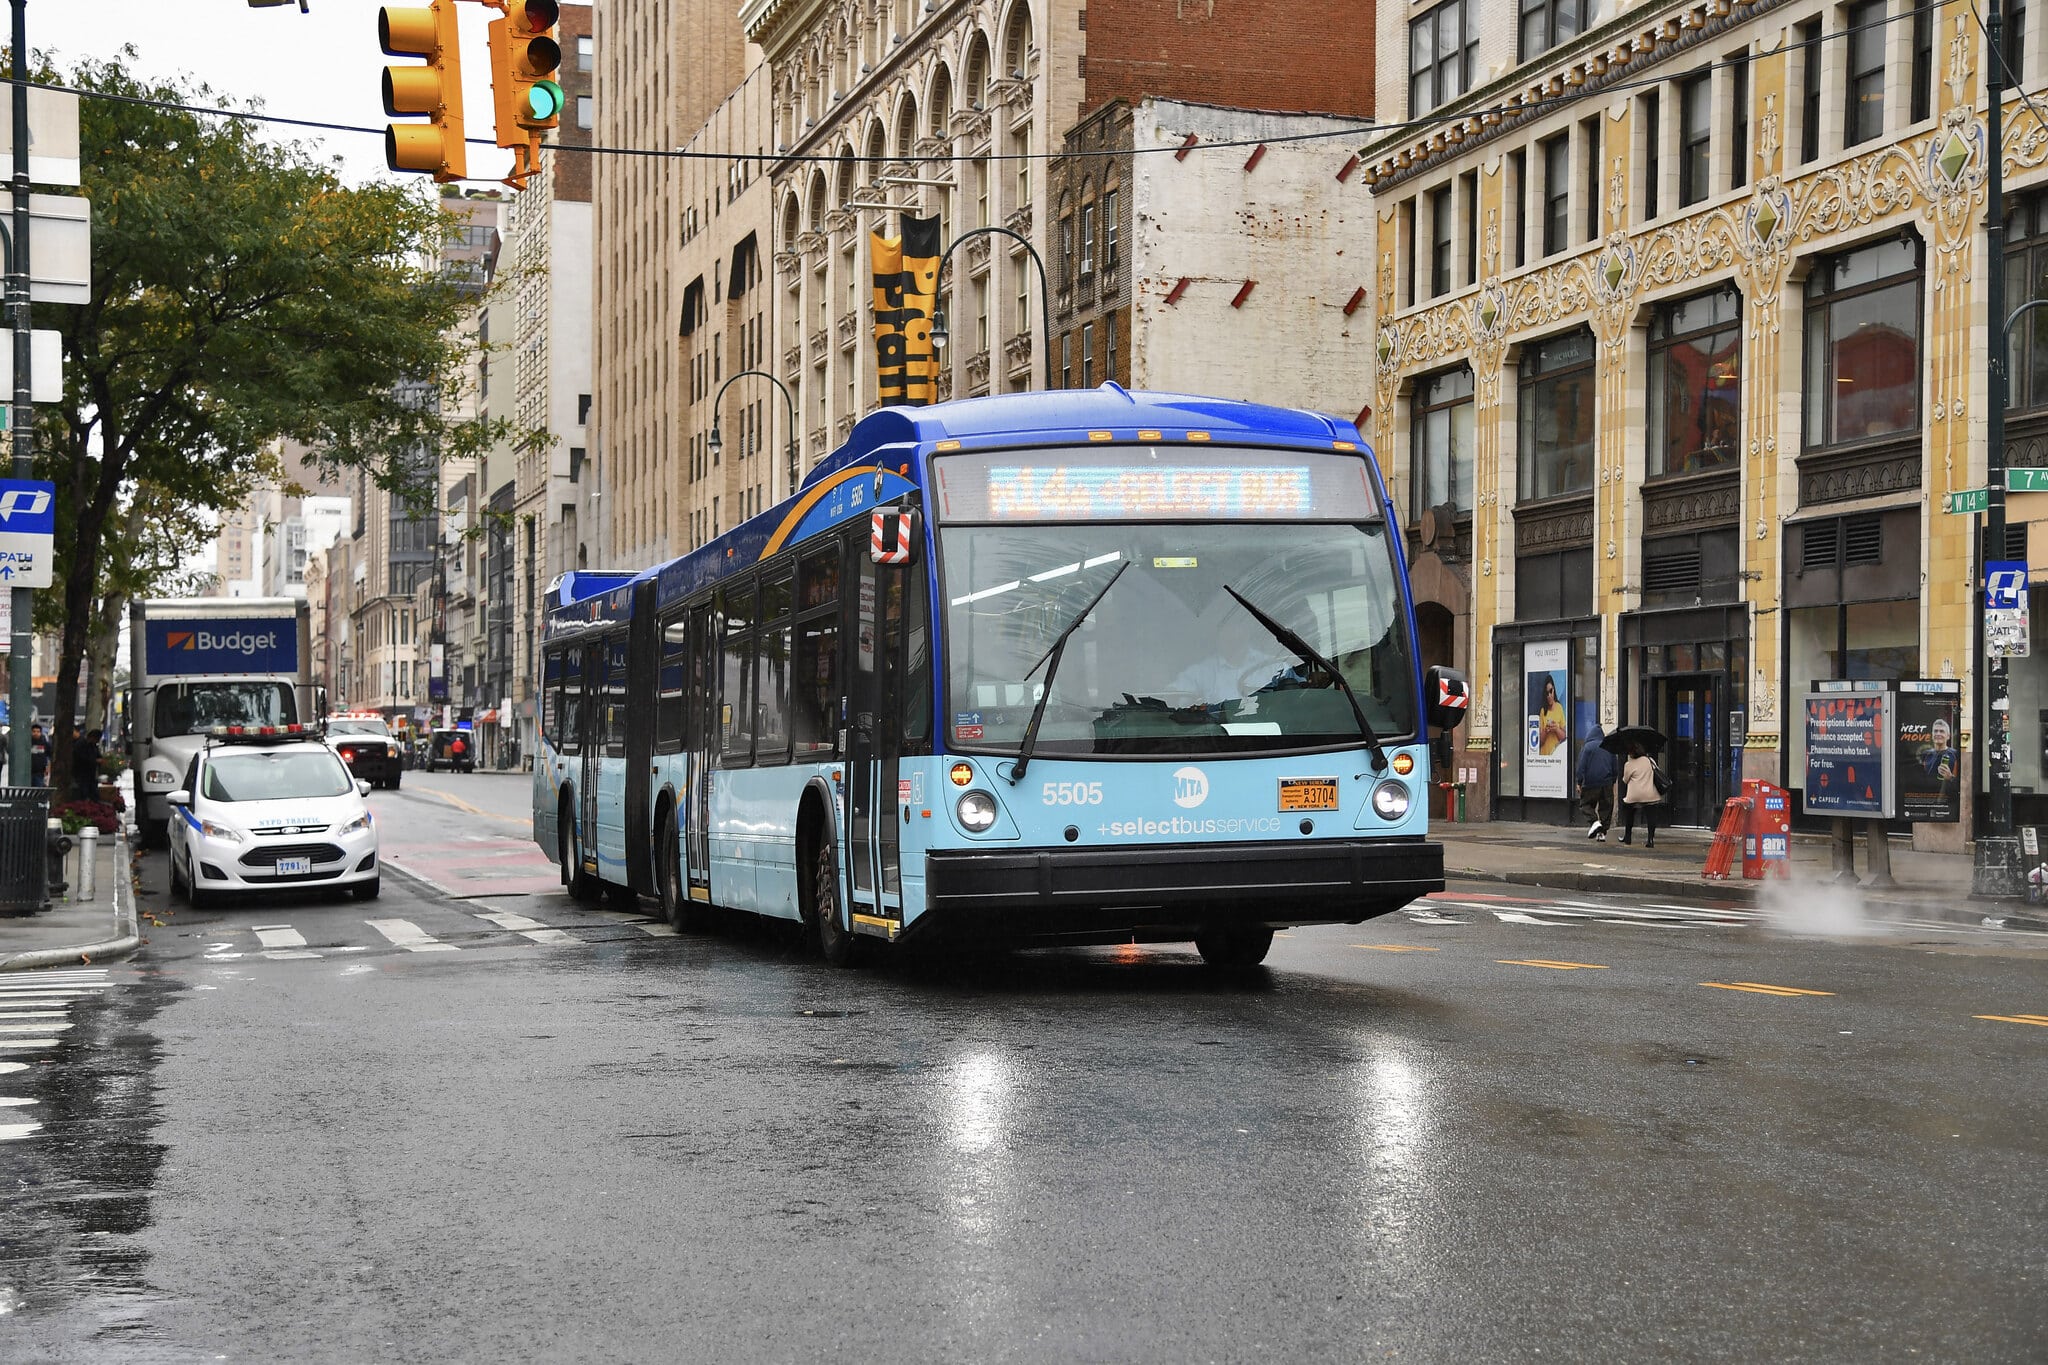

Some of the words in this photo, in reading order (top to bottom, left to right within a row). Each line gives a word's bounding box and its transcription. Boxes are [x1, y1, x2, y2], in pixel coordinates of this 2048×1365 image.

[902, 256, 939, 405] Pratt
[873, 274, 906, 406] Pratt
[2024, 471, 2034, 489] 7
[1955, 495, 1963, 512] W
[1966, 493, 1976, 511] 14
[1980, 491, 1986, 501] ST
[198, 631, 277, 655] Budget
[1862, 682, 1879, 690] TITAN
[1915, 683, 1944, 692] TITAN
[1810, 717, 1845, 728] Prescriptions
[1846, 717, 1874, 727] delivered.
[1900, 722, 1927, 733] NEXT
[1810, 732, 1836, 741] Insurance
[1837, 732, 1865, 743] accepted.
[1900, 733, 1931, 742] MOVE
[1810, 744, 1842, 755] Pharmacists
[1844, 745, 1856, 755] who
[1856, 747, 1871, 756] text.
[1810, 758, 1820, 768] For
[1821, 758, 1835, 768] free.
[1042, 782, 1103, 806] 5505
[1173, 773, 1206, 803] MTA
[1310, 787, 1334, 803] 3704
[286, 817, 320, 825] TRAFFIC
